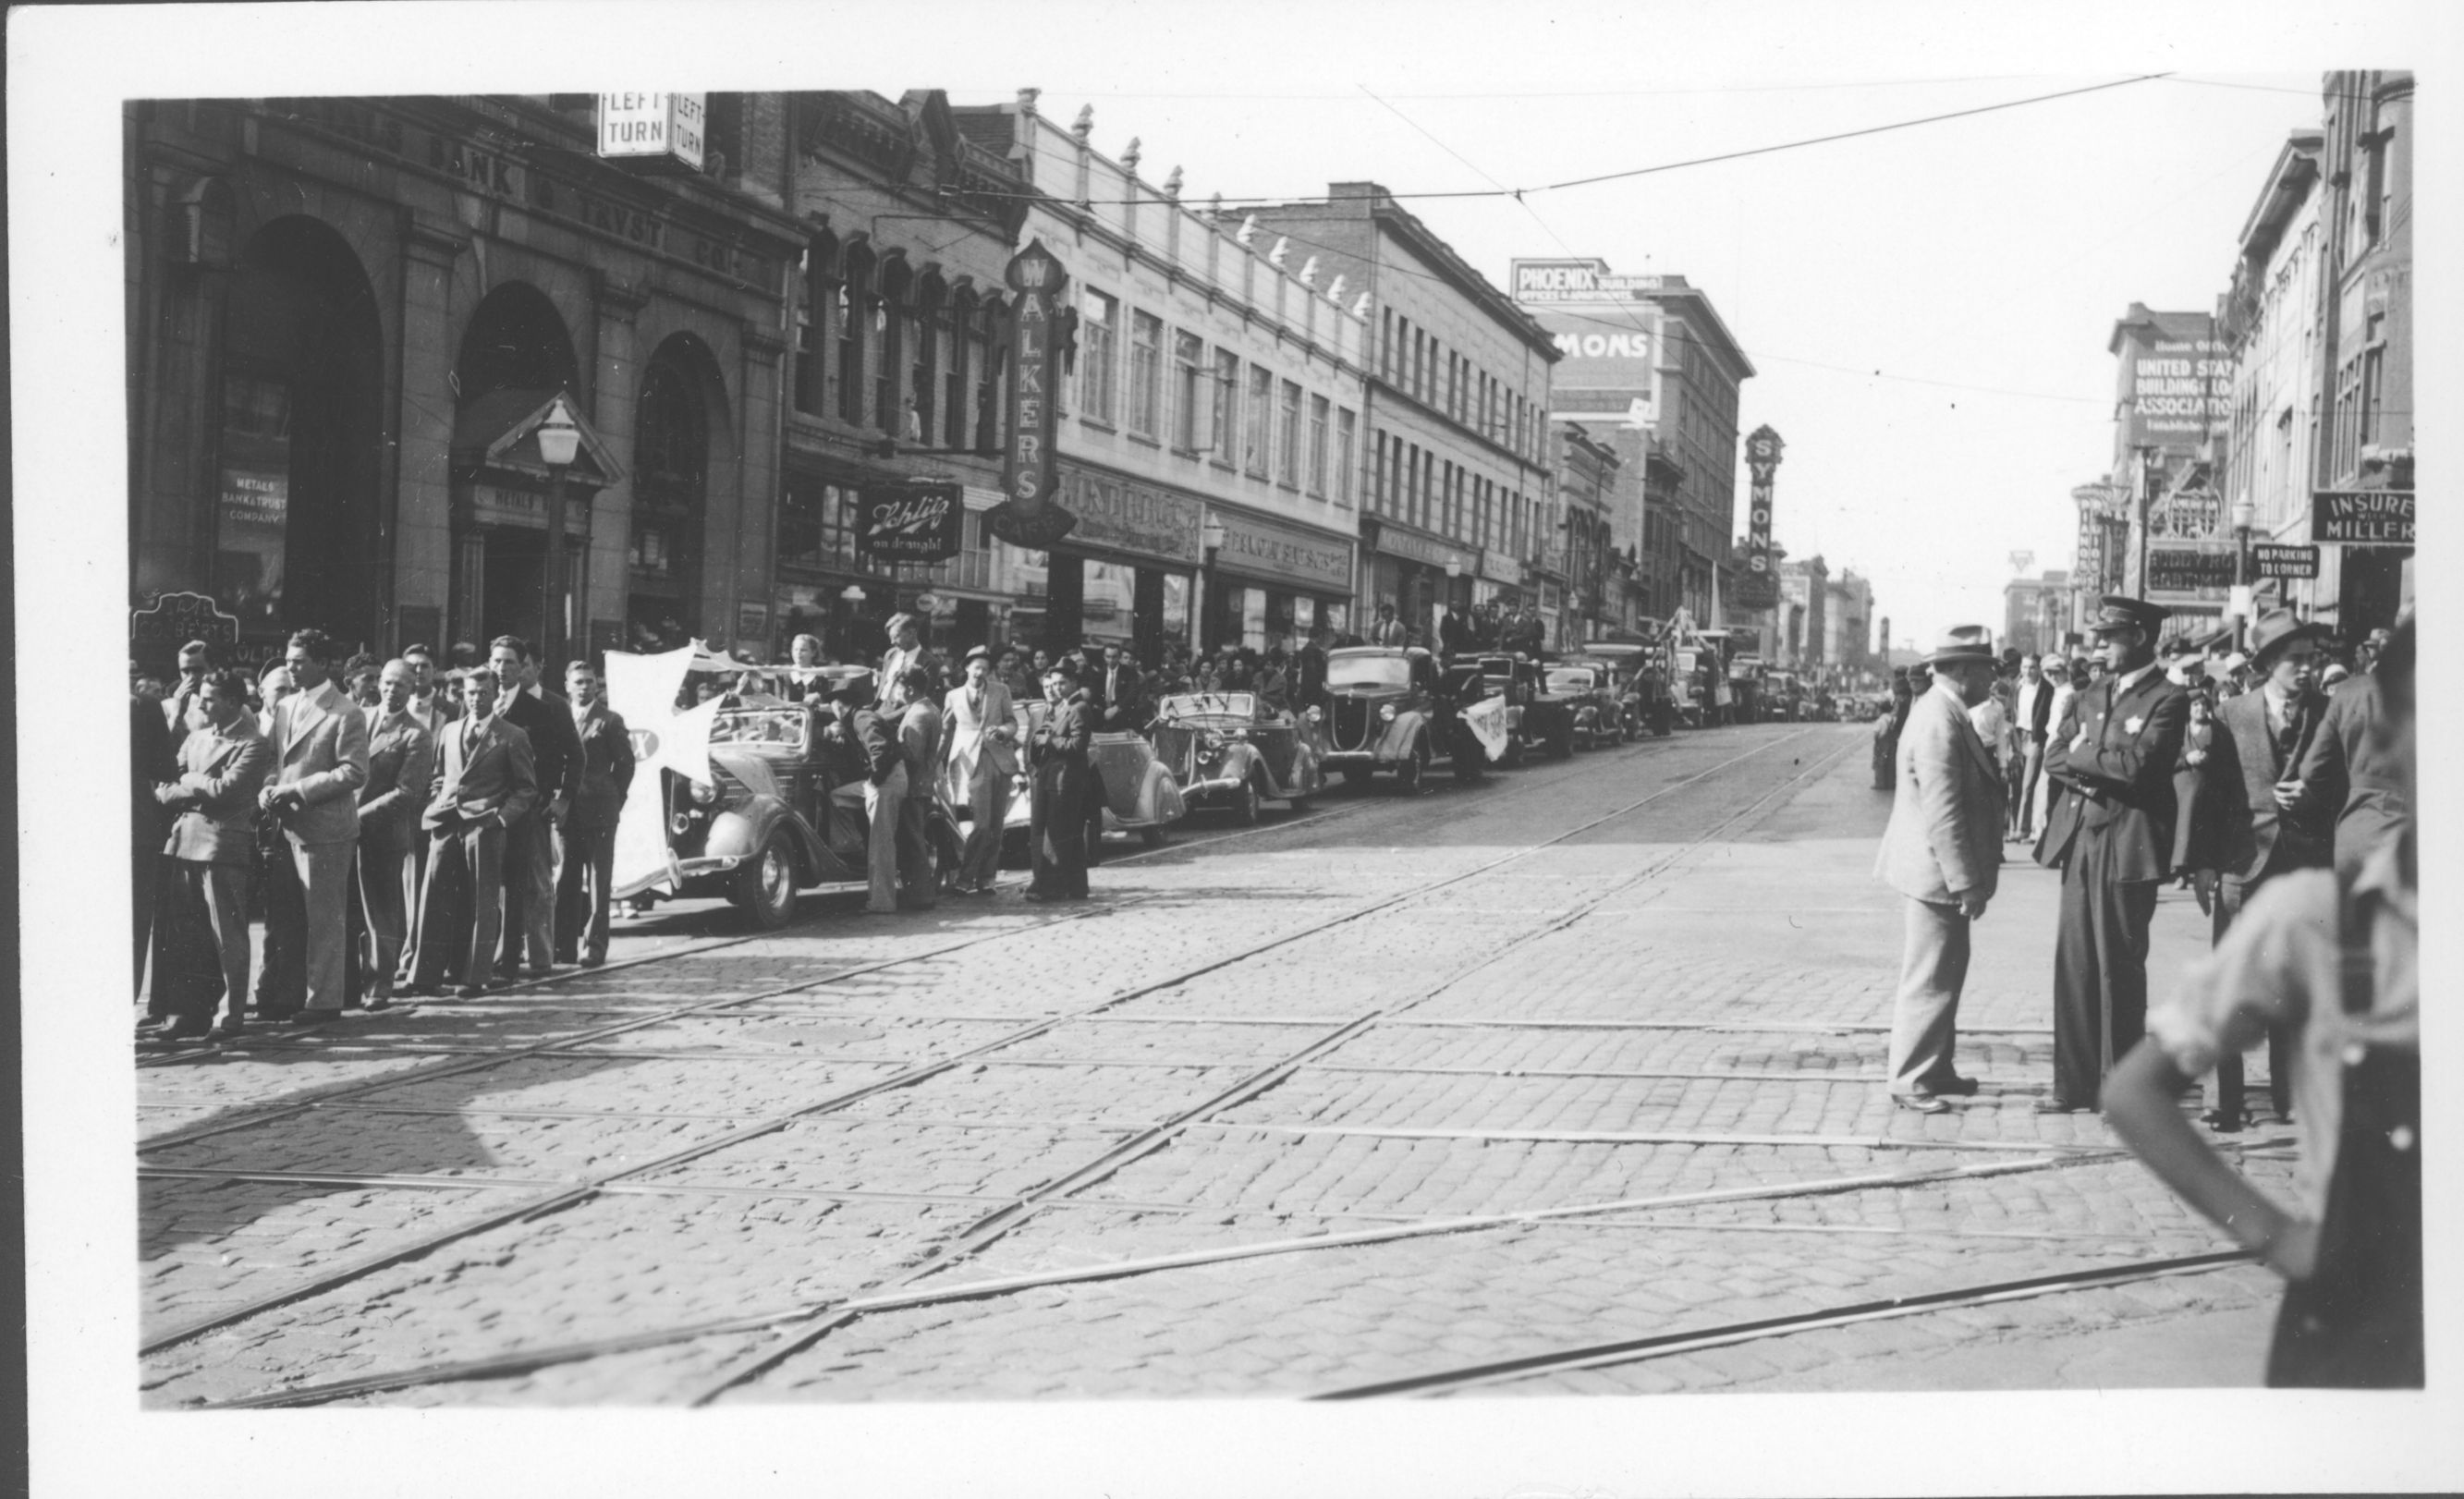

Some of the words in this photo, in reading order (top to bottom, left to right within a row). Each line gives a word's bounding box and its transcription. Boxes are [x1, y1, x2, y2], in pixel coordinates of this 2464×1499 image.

[611, 92, 659, 112] LEFT
[677, 93, 701, 125] LEFT
[608, 121, 663, 143] TURN
[677, 124, 701, 156] TURN
[1519, 267, 1596, 291] PHOENIX
[1598, 278, 1659, 290] BUILDING
[2137, 358, 2191, 377] UNITED
[1015, 258, 1048, 499] WALKERS
[2136, 377, 2199, 396] BUILDING
[237, 477, 275, 493] METALS
[1751, 439, 1773, 572] SYMONS
[2330, 494, 2415, 518] INSURE
[229, 509, 280, 524] COMPANY
[867, 496, 950, 536] Schlitz
[2090, 499, 2102, 573] RDIOS
[2326, 520, 2415, 540] MILLER
[872, 540, 889, 549] on
[891, 536, 943, 555] draught
[2258, 549, 2270, 561] NO
[2272, 549, 2313, 561] PARKING
[2261, 563, 2273, 575] TO
[2274, 563, 2312, 575] CORNER
